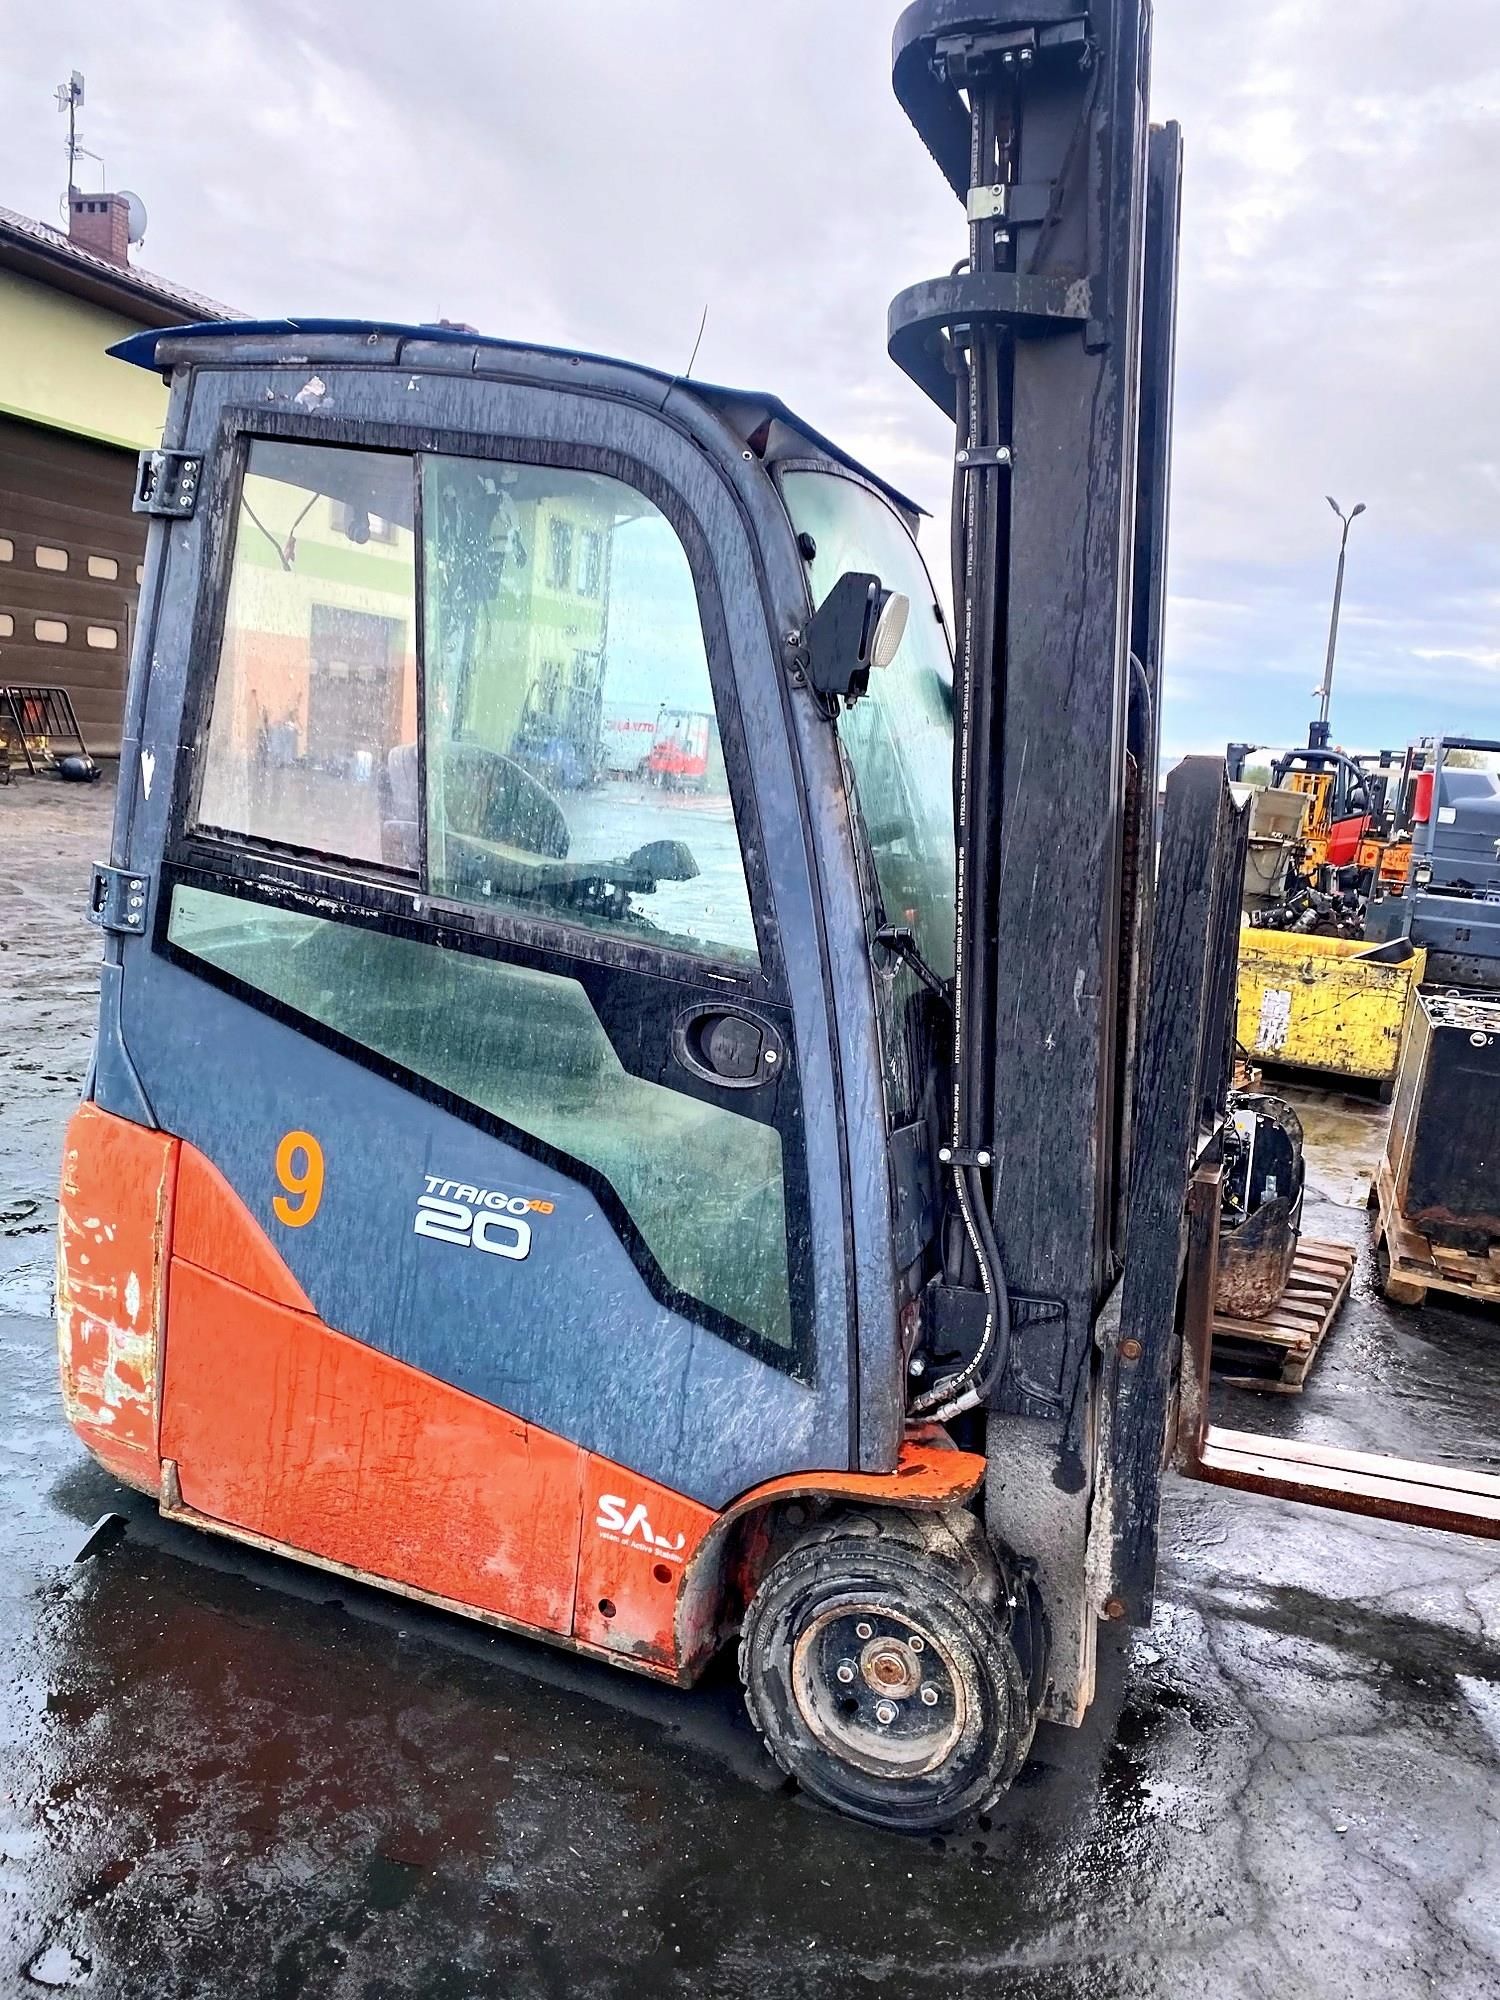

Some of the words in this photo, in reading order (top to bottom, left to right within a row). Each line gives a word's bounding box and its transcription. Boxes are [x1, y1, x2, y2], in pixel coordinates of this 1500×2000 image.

[273, 1131, 325, 1227] 9
[414, 1195, 532, 1261] 20
[631, 1540, 653, 1554] Active
